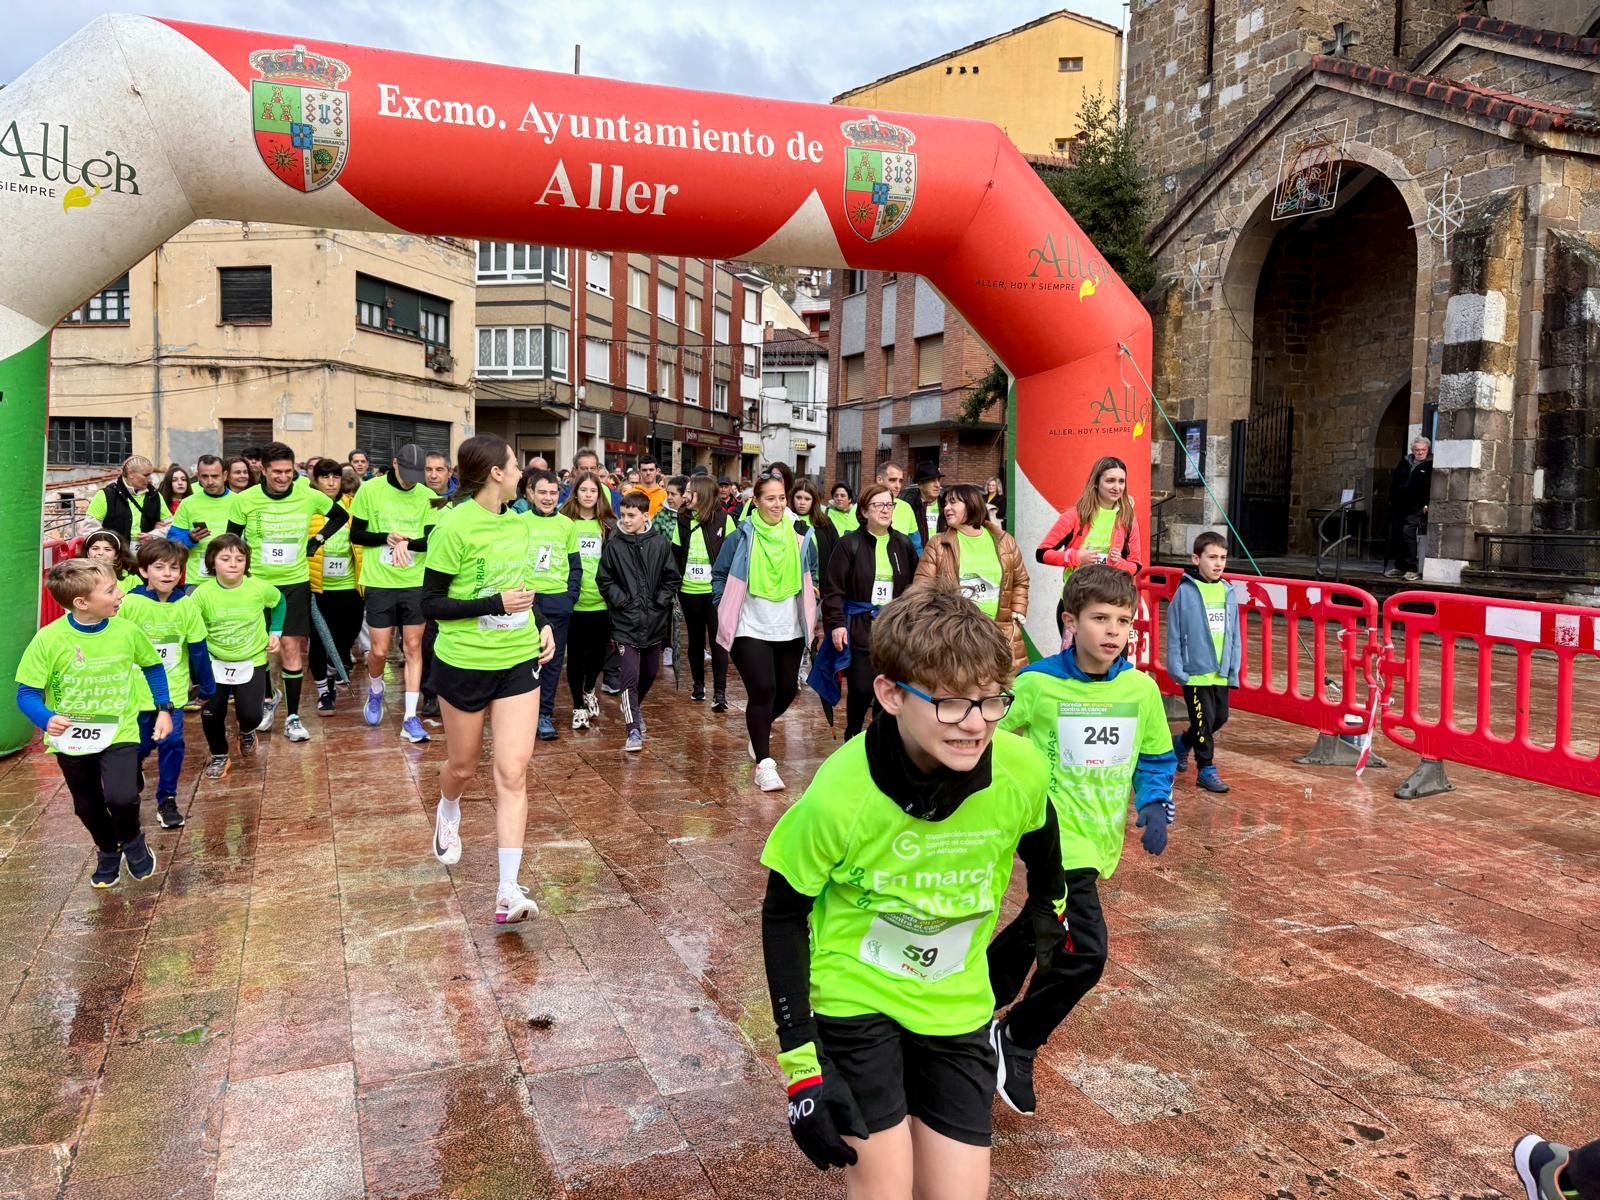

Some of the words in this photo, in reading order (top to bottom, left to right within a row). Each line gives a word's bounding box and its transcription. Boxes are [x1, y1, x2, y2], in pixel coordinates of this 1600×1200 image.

[377, 83, 506, 131] Excmo.
[518, 100, 775, 157] Ayuntamiento
[786, 130, 825, 164] de
[534, 158, 679, 217] Aller
[1010, 282, 1028, 290] HOY
[1031, 282, 1037, 290] Y
[1039, 282, 1076, 291] SIEMPRE
[1102, 426, 1131, 434] SIEMPRE
[581, 540, 596, 549] 247
[272, 548, 284, 557] 58
[329, 561, 343, 569] 211
[692, 567, 704, 575] 163
[877, 587, 887, 596] 31
[1209, 613, 1224, 622] 265
[224, 667, 236, 677] 77
[64, 686, 117, 697] contra
[71, 727, 101, 740] 205
[1084, 726, 1120, 745] 245
[873, 870, 908, 892] En
[902, 944, 938, 967] 59
